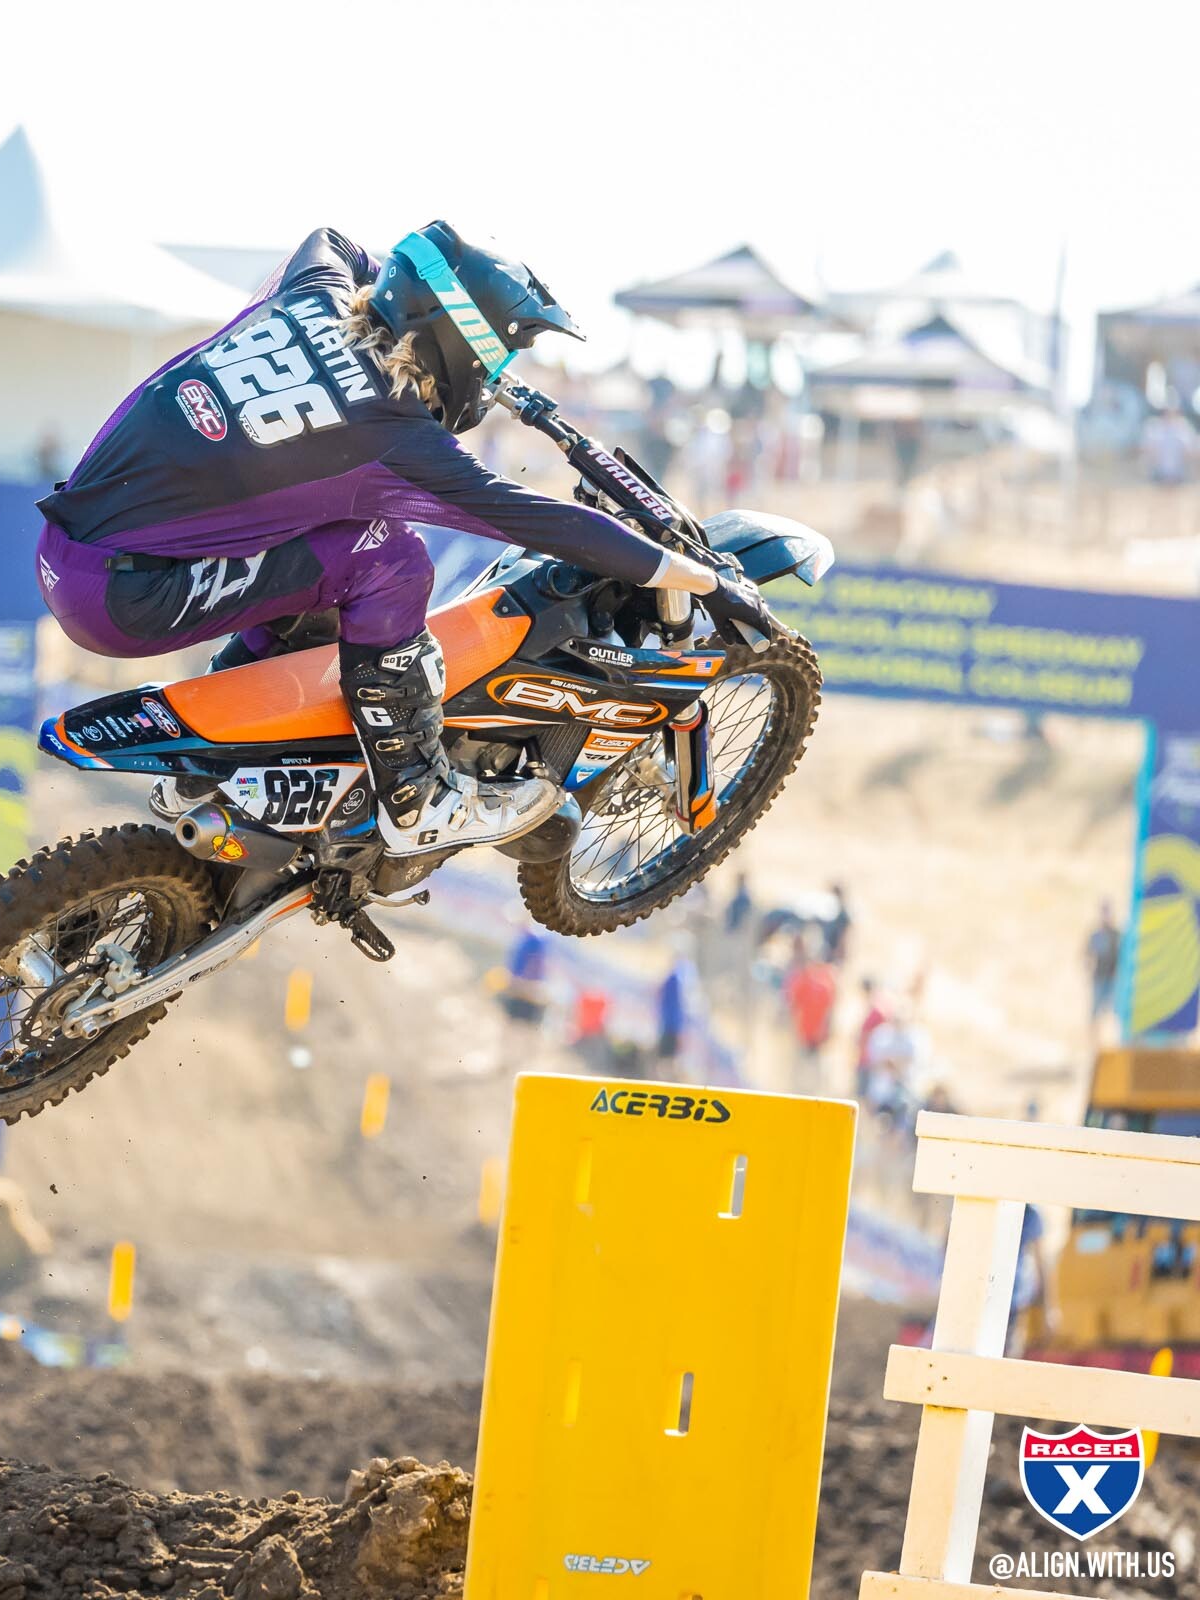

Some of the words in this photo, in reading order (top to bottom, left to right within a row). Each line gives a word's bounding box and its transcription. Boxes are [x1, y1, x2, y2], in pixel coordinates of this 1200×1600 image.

[287, 297, 377, 402] MARTIN
[205, 317, 343, 445] 926
[183, 385, 221, 433] BMC
[587, 446, 672, 520] RENTHAL
[588, 647, 634, 664] OUTLIER
[360, 706, 394, 727] G
[503, 680, 657, 723] BMC
[259, 768, 340, 826] 926
[590, 1088, 732, 1124] ACERBIS
